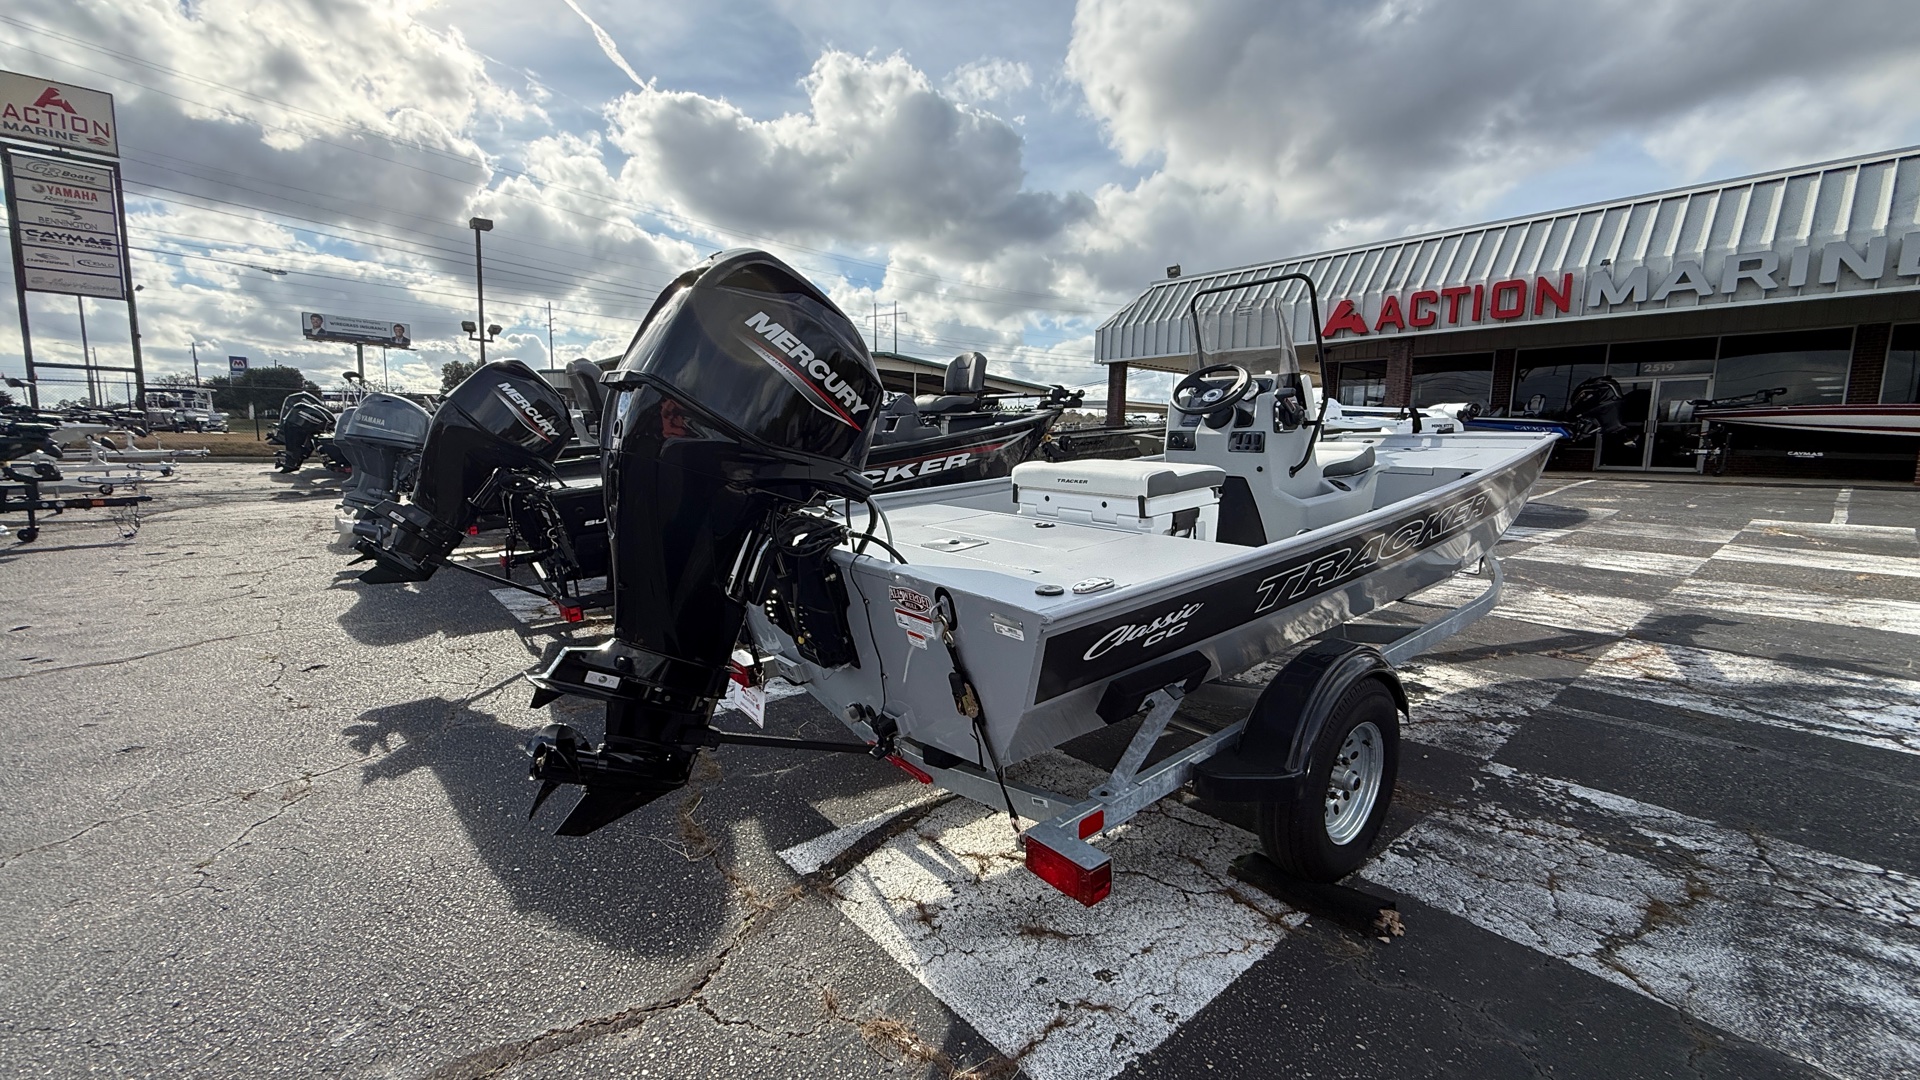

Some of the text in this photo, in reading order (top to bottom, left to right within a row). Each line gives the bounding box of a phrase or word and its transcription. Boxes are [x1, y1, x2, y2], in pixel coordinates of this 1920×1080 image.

[2, 103, 110, 138] ACTION
[3, 121, 80, 142] MARINE
[62, 171, 96, 181] Boats
[47, 185, 98, 202] YAMAHA
[38, 216, 97, 230] BENNINGTON
[25, 229, 113, 246] CAYMAS
[1374, 272, 1573, 331] ACTION
[744, 311, 870, 415] MERCURY
[1644, 363, 1675, 372] 2519
[361, 414, 385, 426] YAMAHA
[497, 382, 560, 436] MERCURY
[1254, 488, 1493, 614] TRACKER
[1083, 602, 1204, 661] Classic
[1142, 621, 1188, 647] CC
